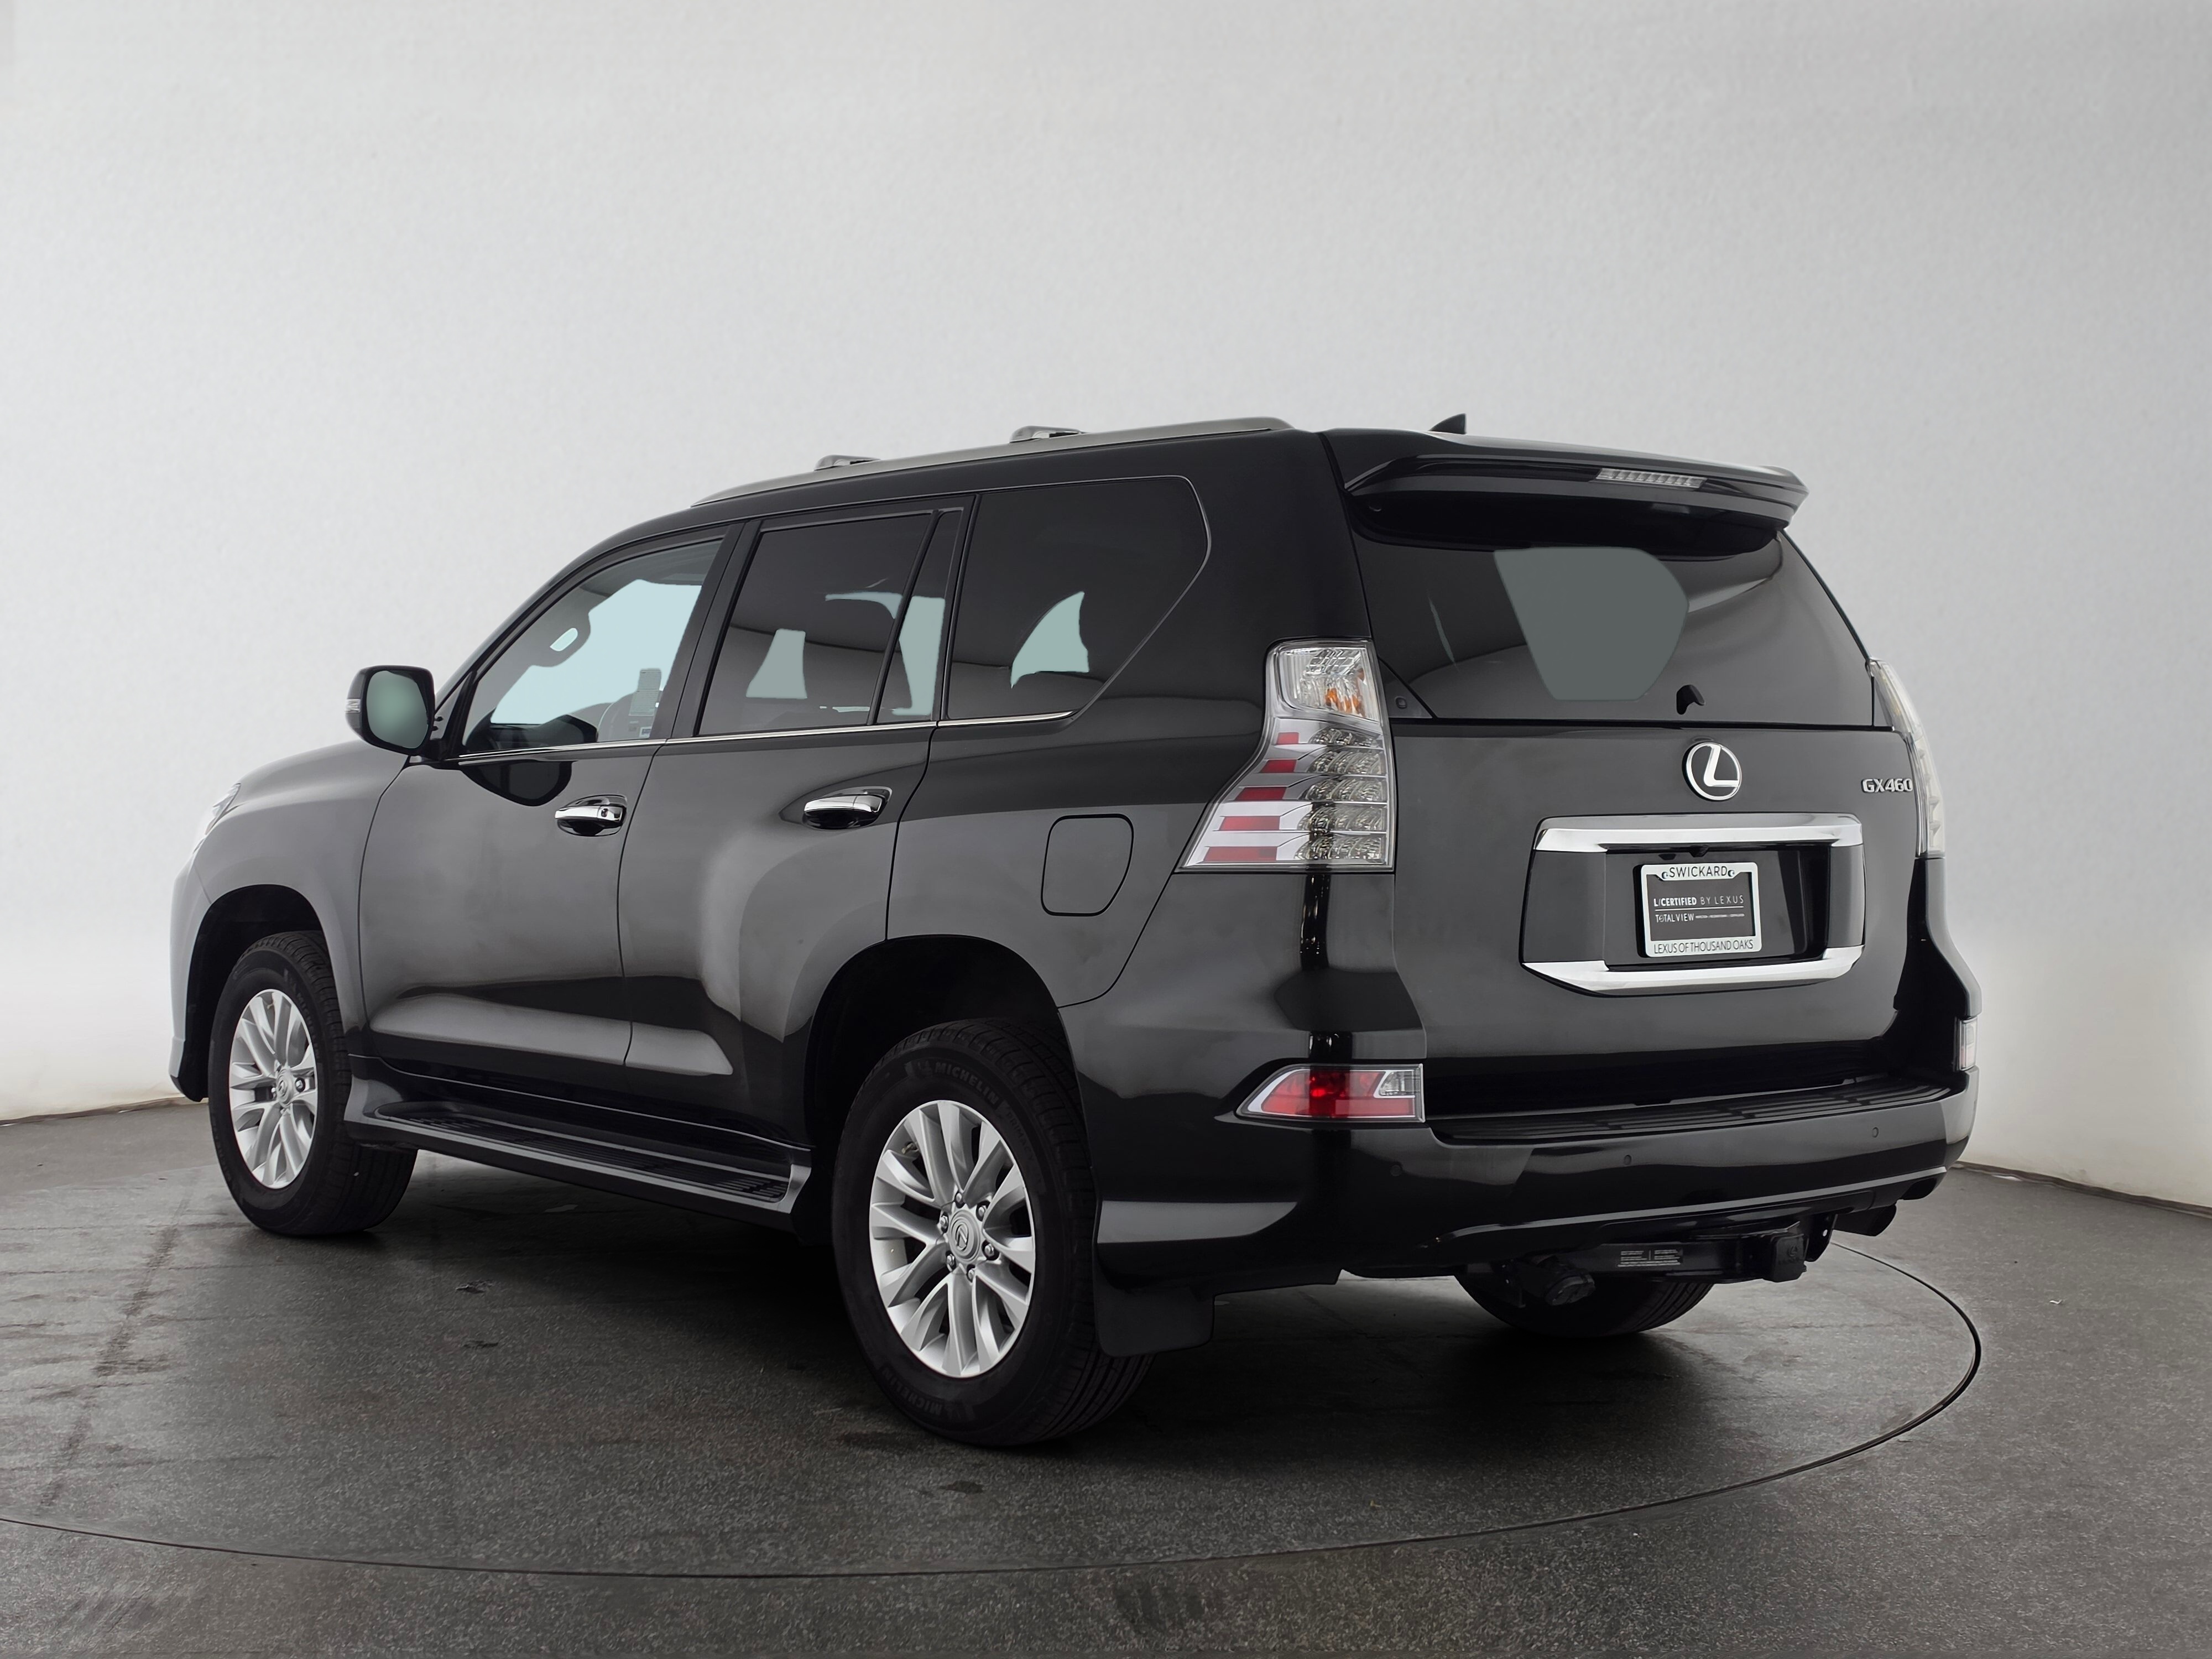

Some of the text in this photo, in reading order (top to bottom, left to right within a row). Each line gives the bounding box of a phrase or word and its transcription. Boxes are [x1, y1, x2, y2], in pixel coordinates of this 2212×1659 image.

[1669, 865, 1728, 878] SWICKARD
[1700, 896, 1711, 905] BY
[1714, 895, 1744, 905] LEXUS
[1676, 913, 1694, 922] VIEW
[1654, 939, 1754, 954] LEXUS OF THOUSAND OAKS
[935, 1061, 999, 1105] MICHELIN
